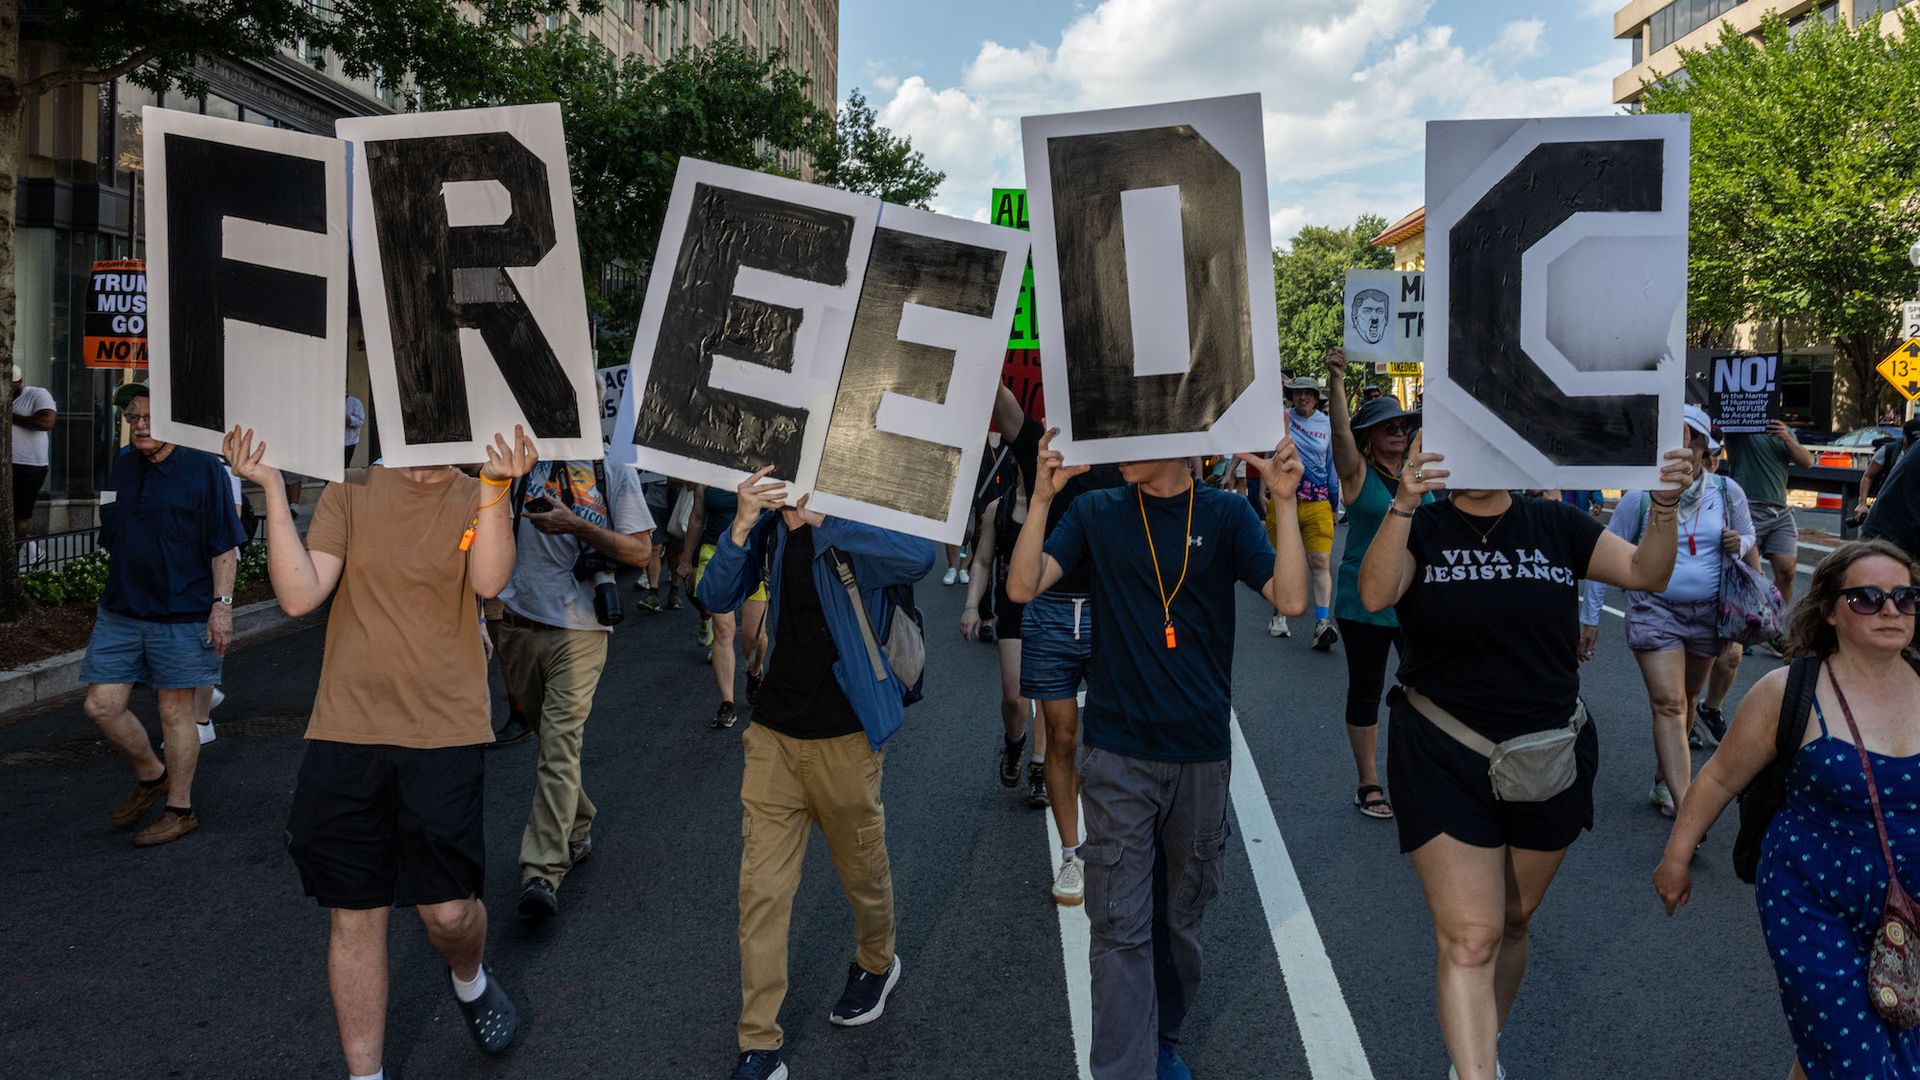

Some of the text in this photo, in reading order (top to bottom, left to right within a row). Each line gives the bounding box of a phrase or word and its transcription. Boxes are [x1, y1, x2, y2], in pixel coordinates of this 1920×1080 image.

[93, 273, 148, 292] TRUM
[97, 294, 147, 313] MUS
[111, 314, 145, 334] GO
[1714, 356, 1777, 393] NO!
[1730, 399, 1769, 407] Humanity
[1442, 548, 1549, 565] VIVA LA
[1423, 563, 1575, 587] RESISTANCE
